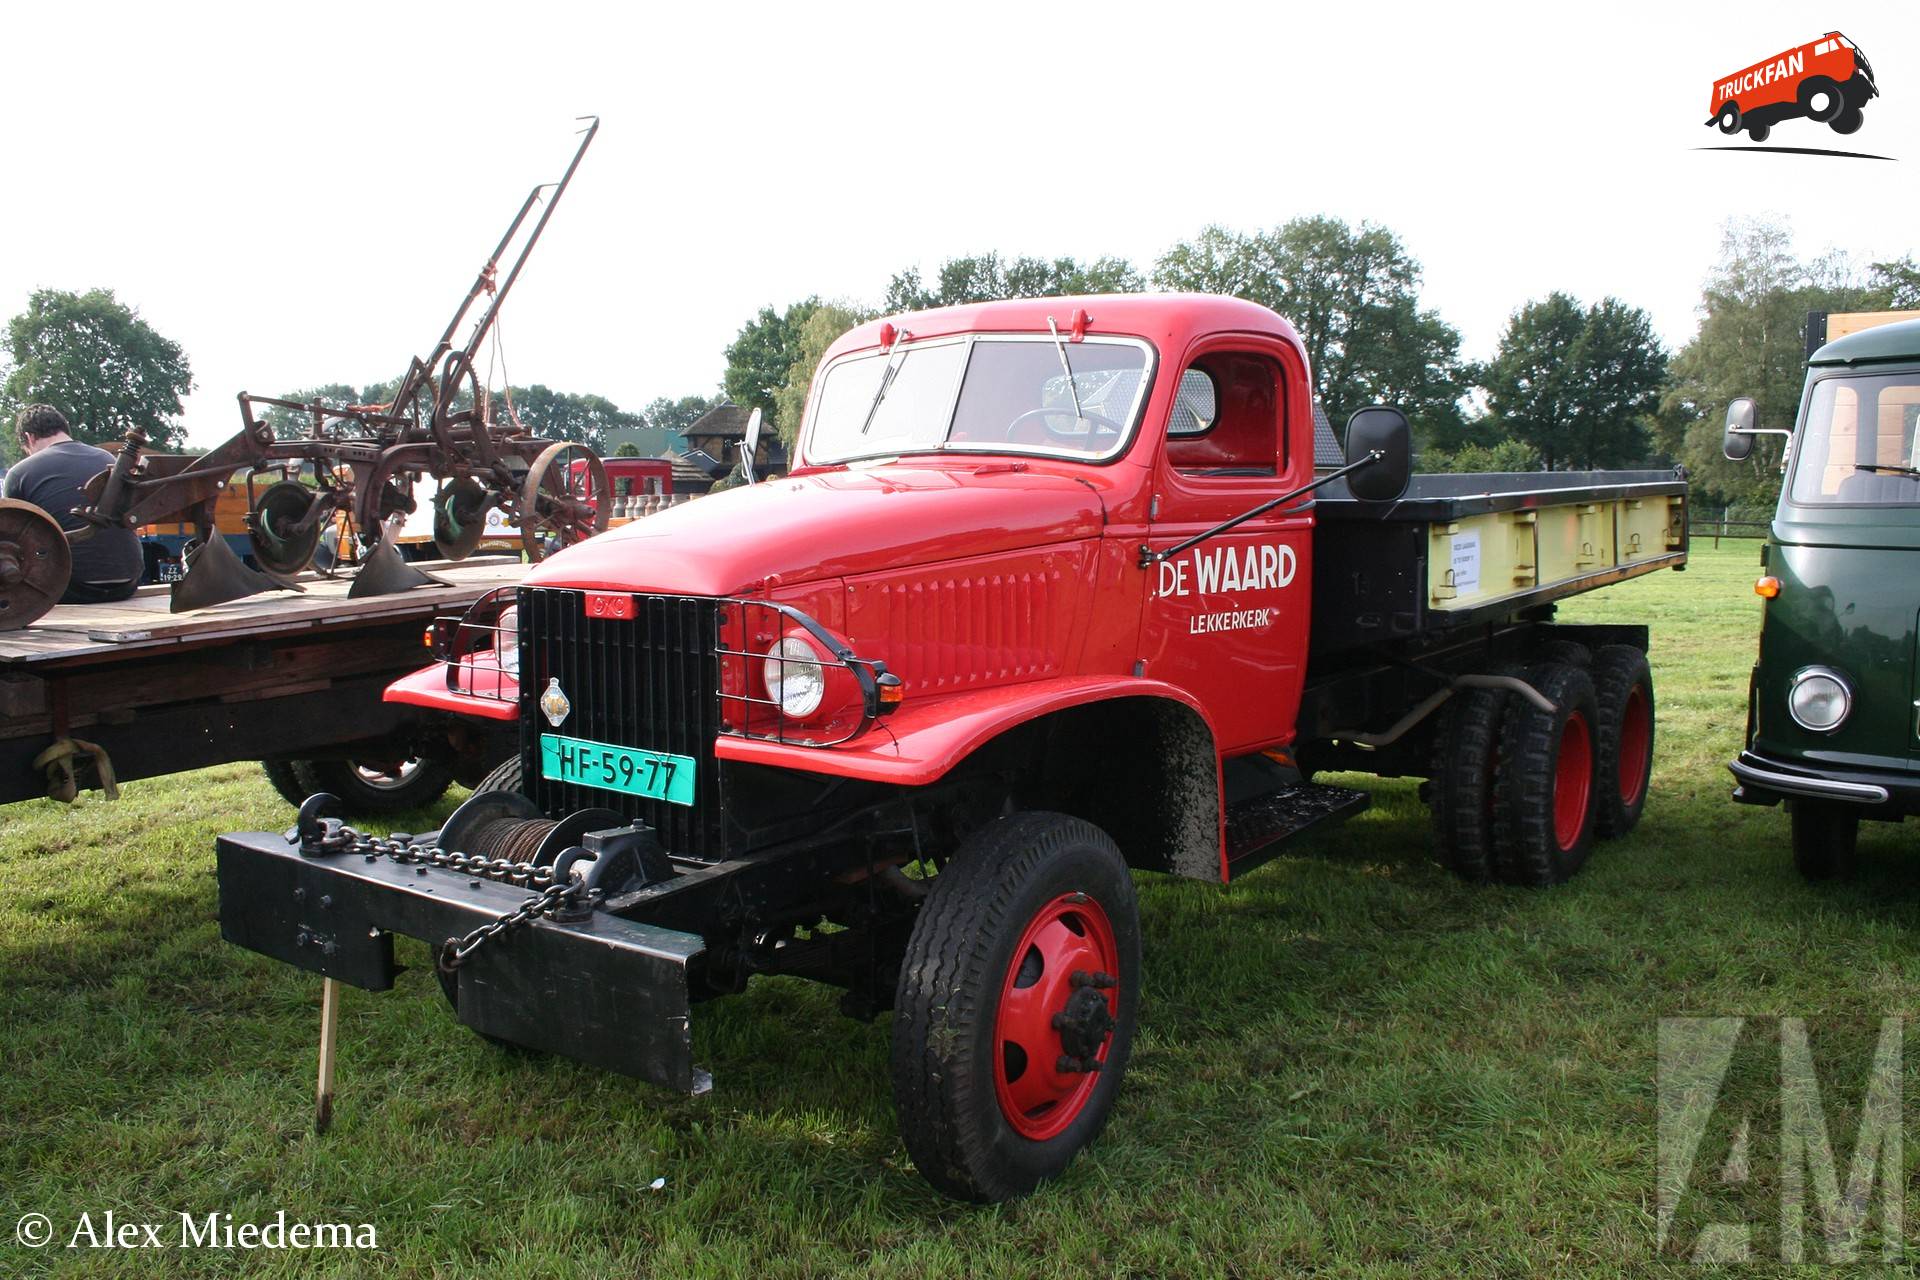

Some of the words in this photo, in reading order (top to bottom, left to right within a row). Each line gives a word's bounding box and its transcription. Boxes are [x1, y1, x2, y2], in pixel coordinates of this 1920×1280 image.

[1159, 560, 1189, 597] DE
[1194, 544, 1297, 594] WAARD
[1190, 609, 1269, 634] LEKKERKERK
[562, 744, 677, 794] HF-59-77
